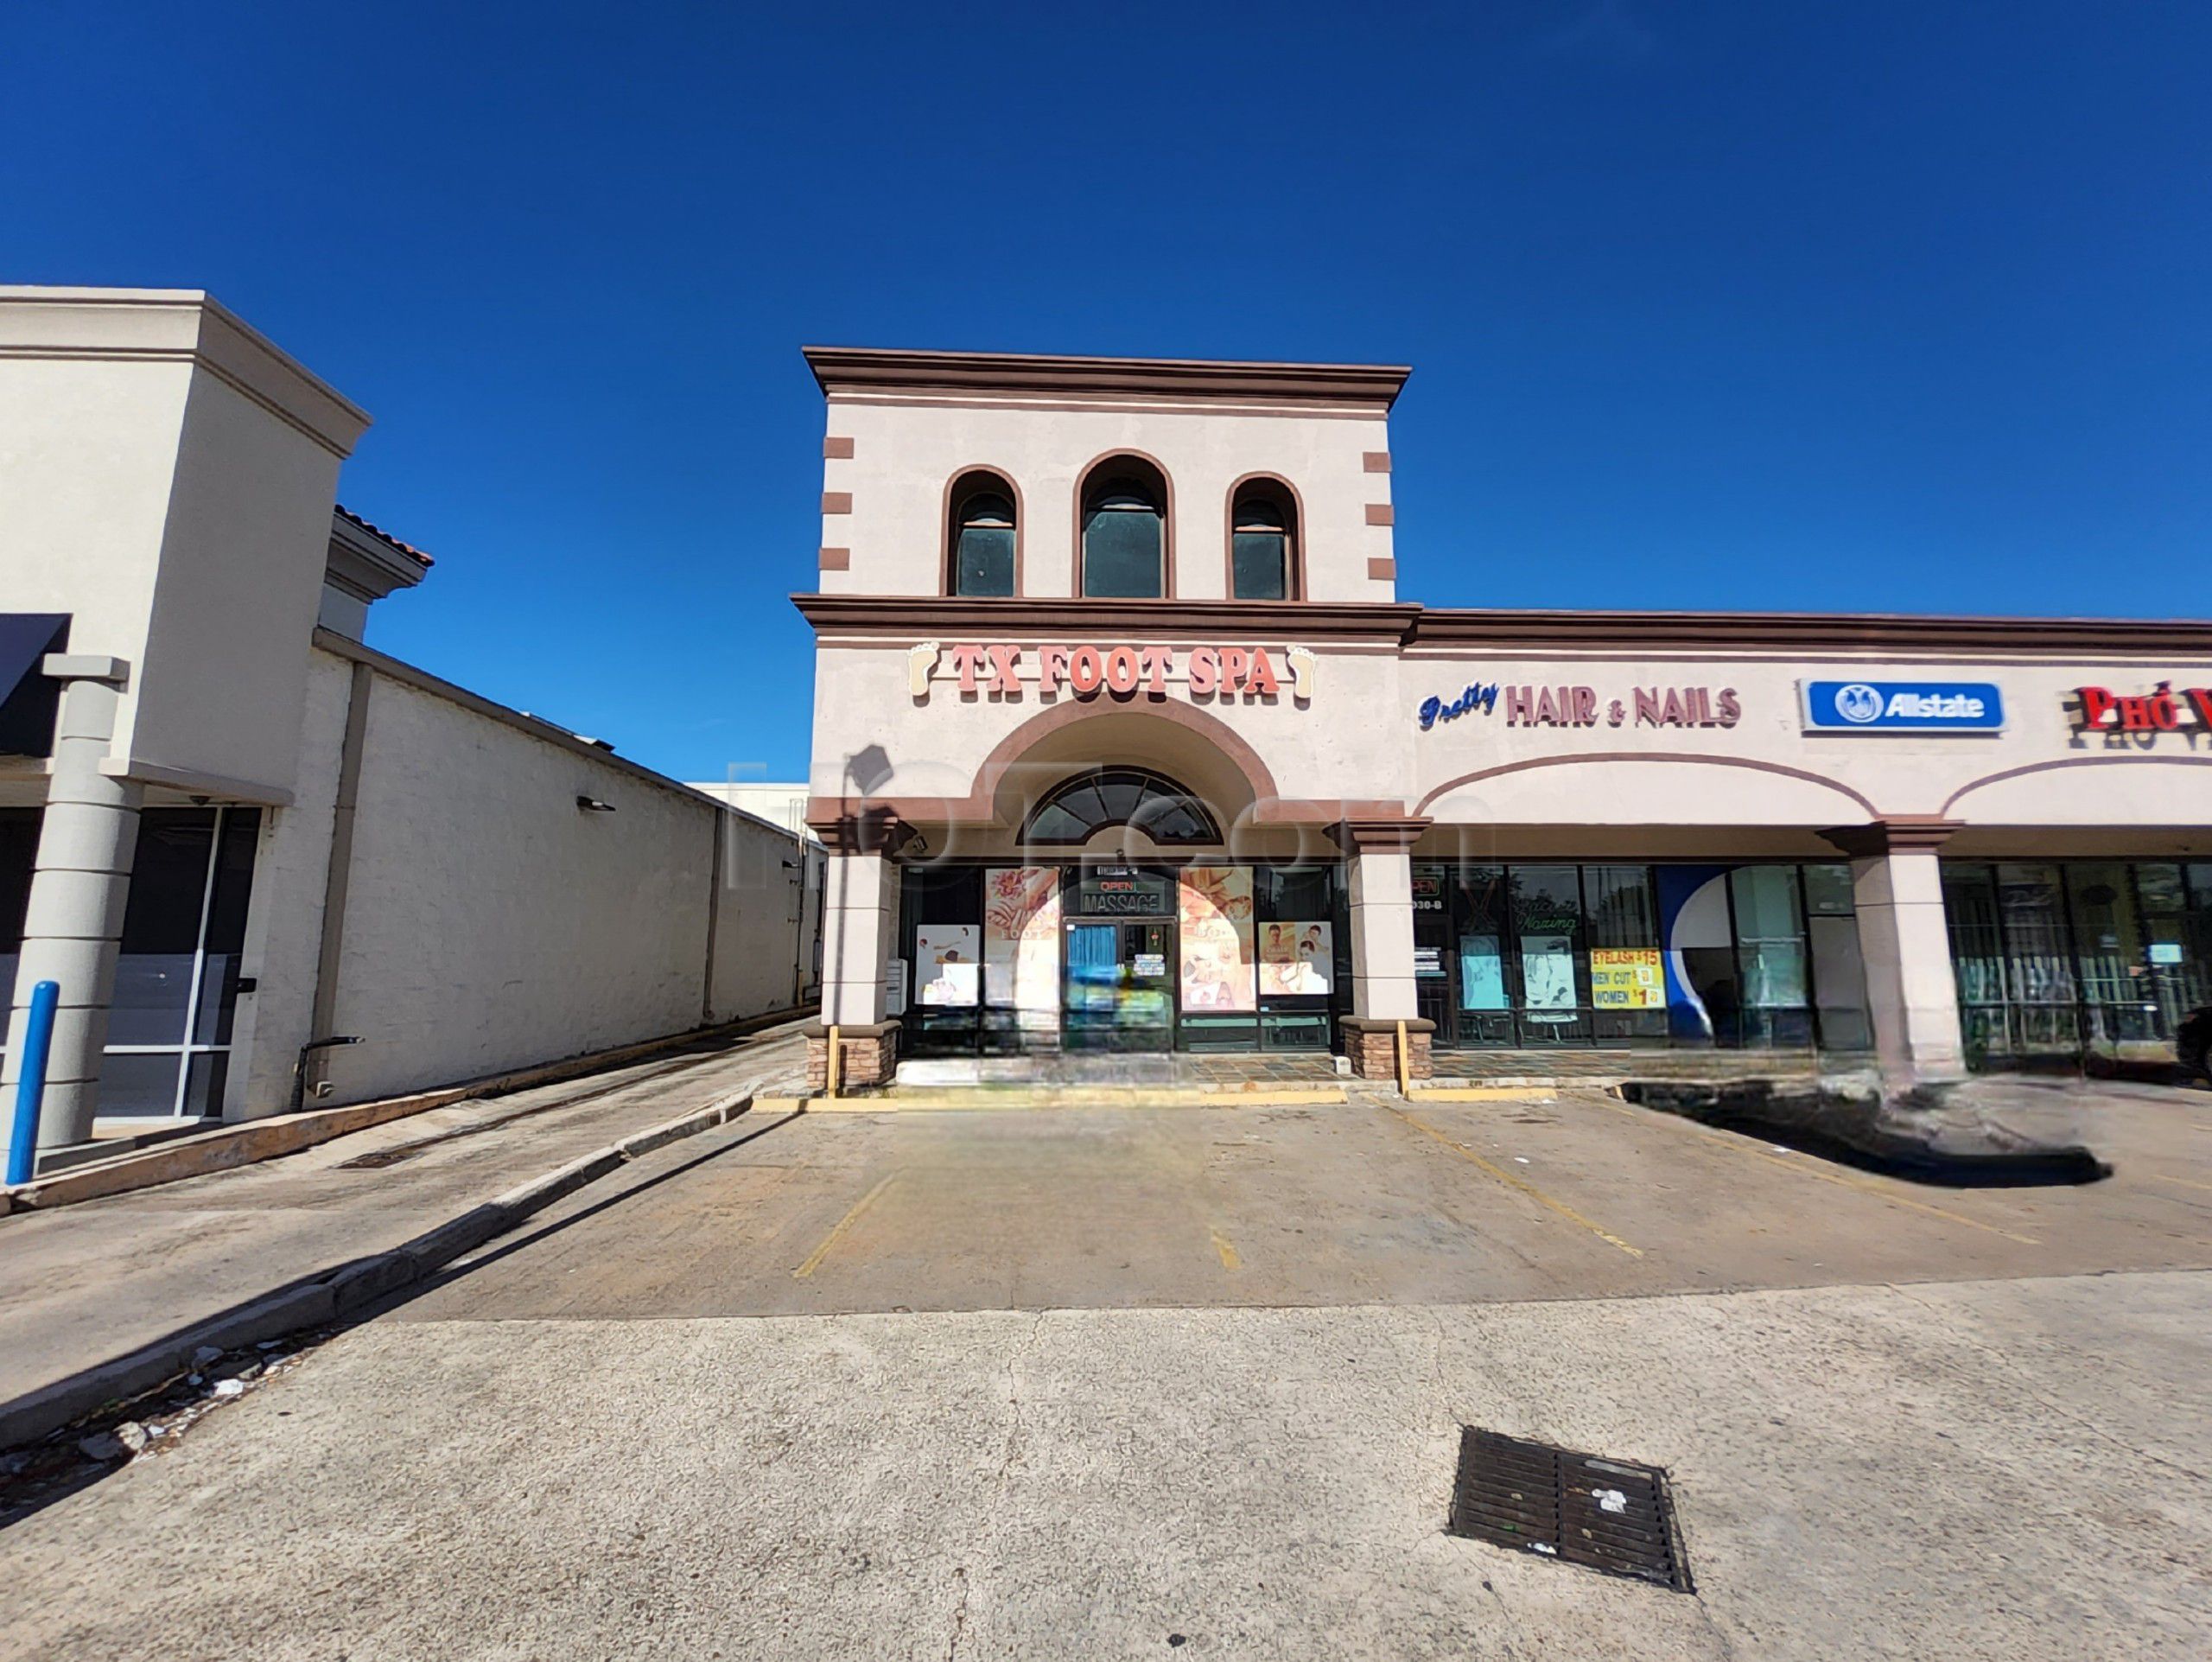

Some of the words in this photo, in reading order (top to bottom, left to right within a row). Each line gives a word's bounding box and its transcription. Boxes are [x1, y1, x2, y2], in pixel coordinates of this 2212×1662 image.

[952, 645, 1022, 692] TX
[1038, 646, 1173, 693] FOOT
[1189, 646, 1281, 694] SPA
[1506, 685, 1599, 725] HAIR
[1606, 699, 1627, 725] &
[1632, 686, 1742, 726] NAILS
[1885, 692, 1986, 718] Allstate
[1100, 882, 1134, 891] OPEN
[1411, 880, 1436, 894] PEN
[1084, 895, 1158, 912] MASSAGE
[1592, 950, 1635, 965] EYELASH
[1592, 971, 1610, 984] MEN
[1613, 971, 1631, 984] CUT
[1594, 990, 1629, 1004] WOMEN
